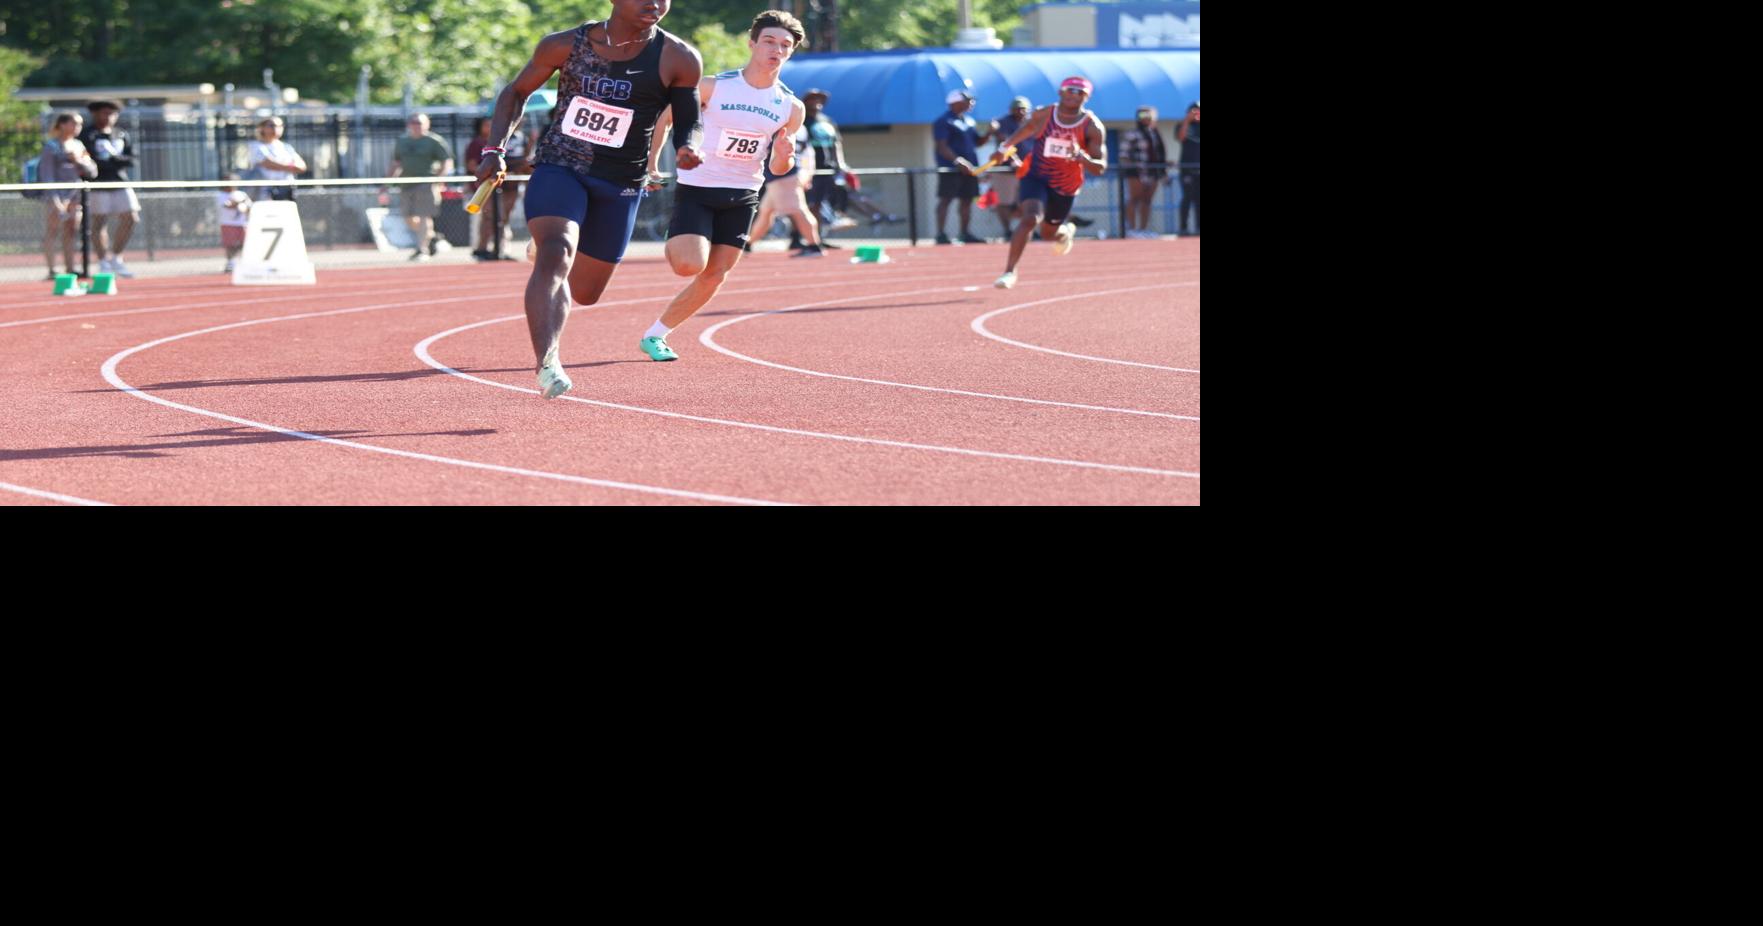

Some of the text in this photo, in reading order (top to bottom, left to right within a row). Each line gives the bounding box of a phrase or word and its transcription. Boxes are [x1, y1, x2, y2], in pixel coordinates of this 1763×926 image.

[582, 76, 632, 100] LCB
[574, 108, 620, 136] 694
[720, 104, 780, 122] MASSAPONAX
[580, 130, 612, 143] ATHLETIC
[726, 137, 759, 154] 793
[261, 228, 283, 261] 7
